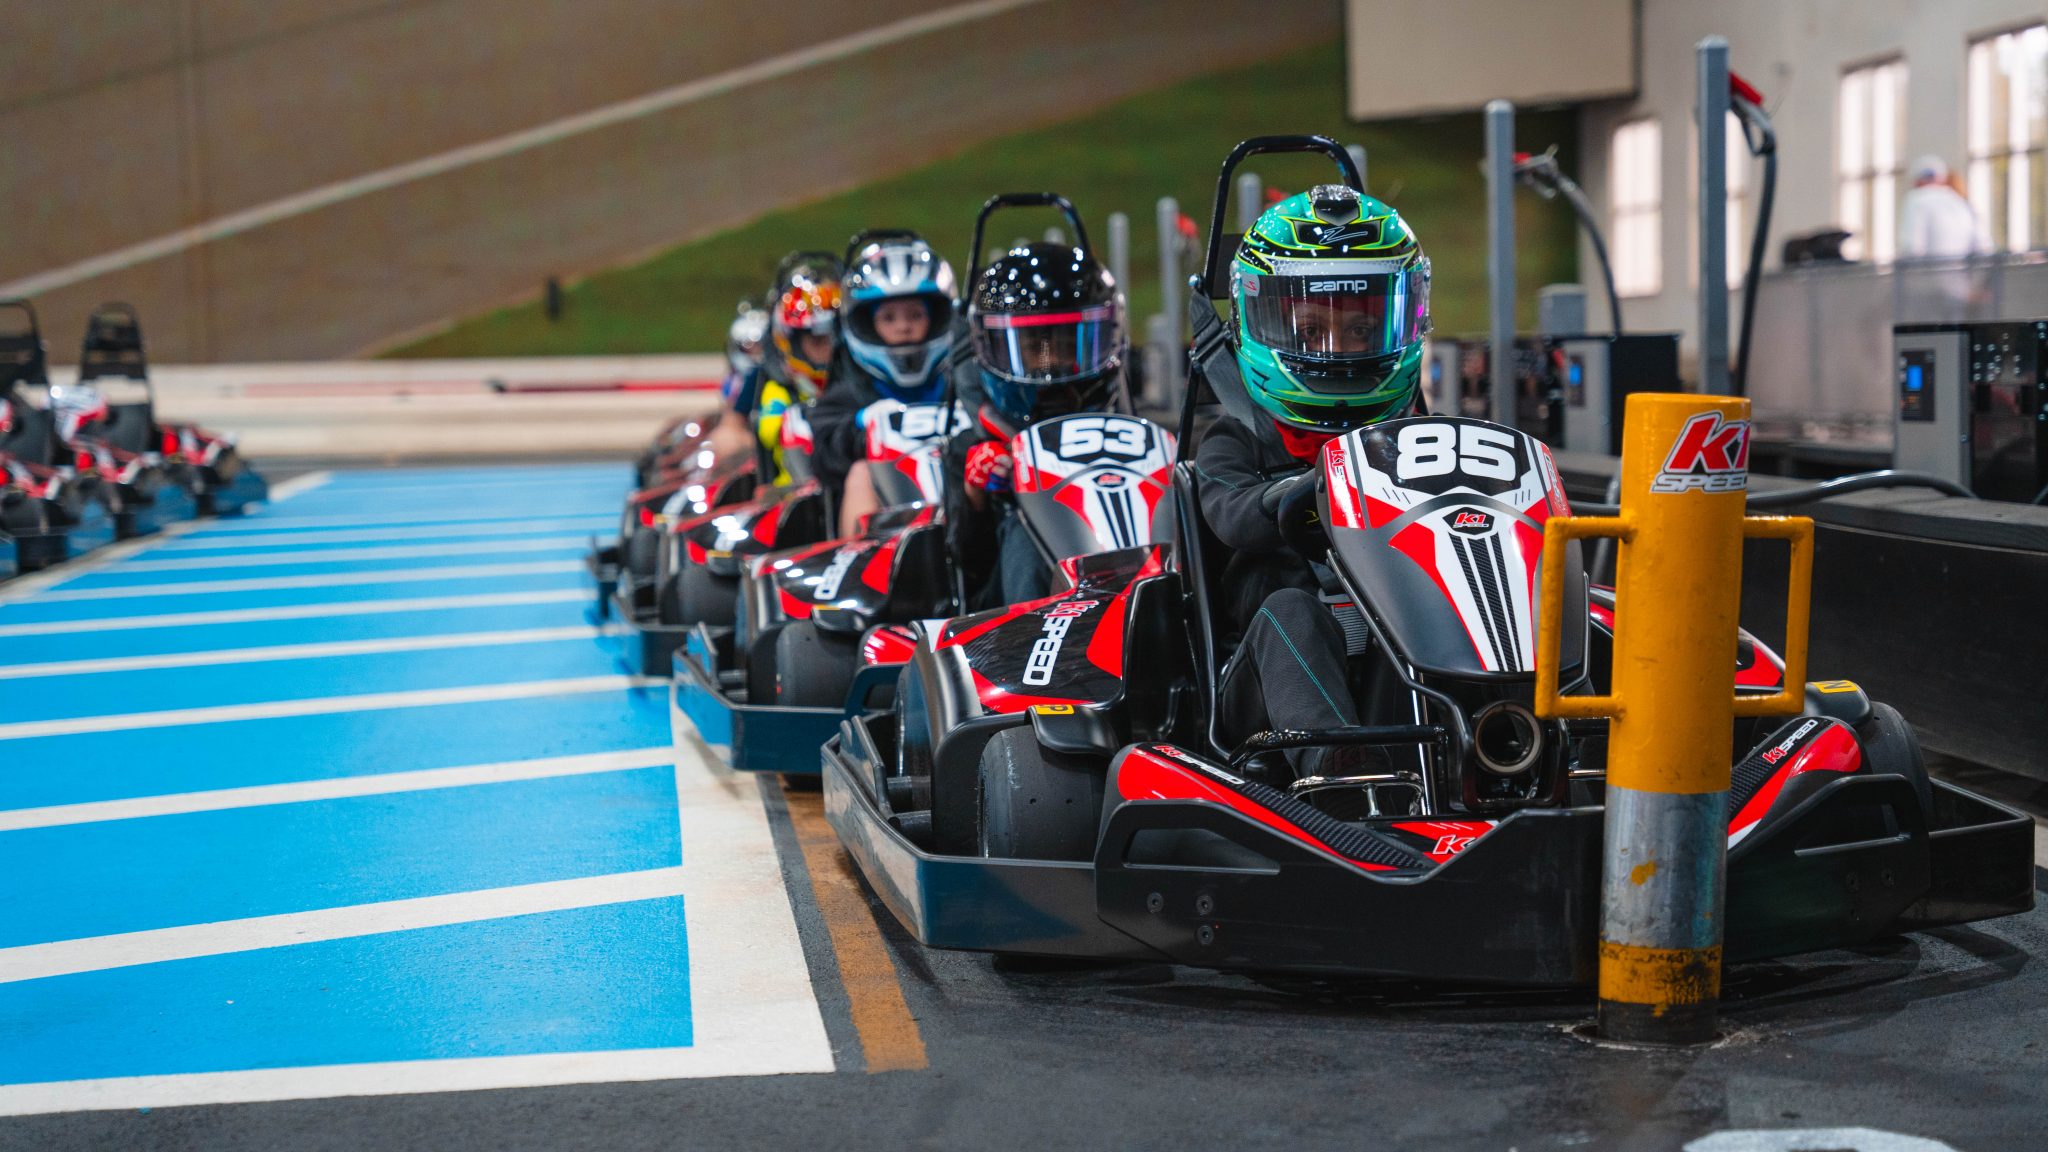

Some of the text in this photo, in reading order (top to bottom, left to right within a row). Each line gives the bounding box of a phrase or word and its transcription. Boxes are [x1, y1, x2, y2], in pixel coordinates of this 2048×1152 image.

[1309, 279, 1368, 294] zamp
[1060, 417, 1147, 458] 53
[1397, 423, 1516, 481] 85
[1652, 474, 1748, 492] SPEE
[1455, 511, 1487, 524] K1
[1022, 616, 1074, 686] SPEED
[1762, 719, 1819, 764] K1 SPEED
[1432, 834, 1476, 855] K
